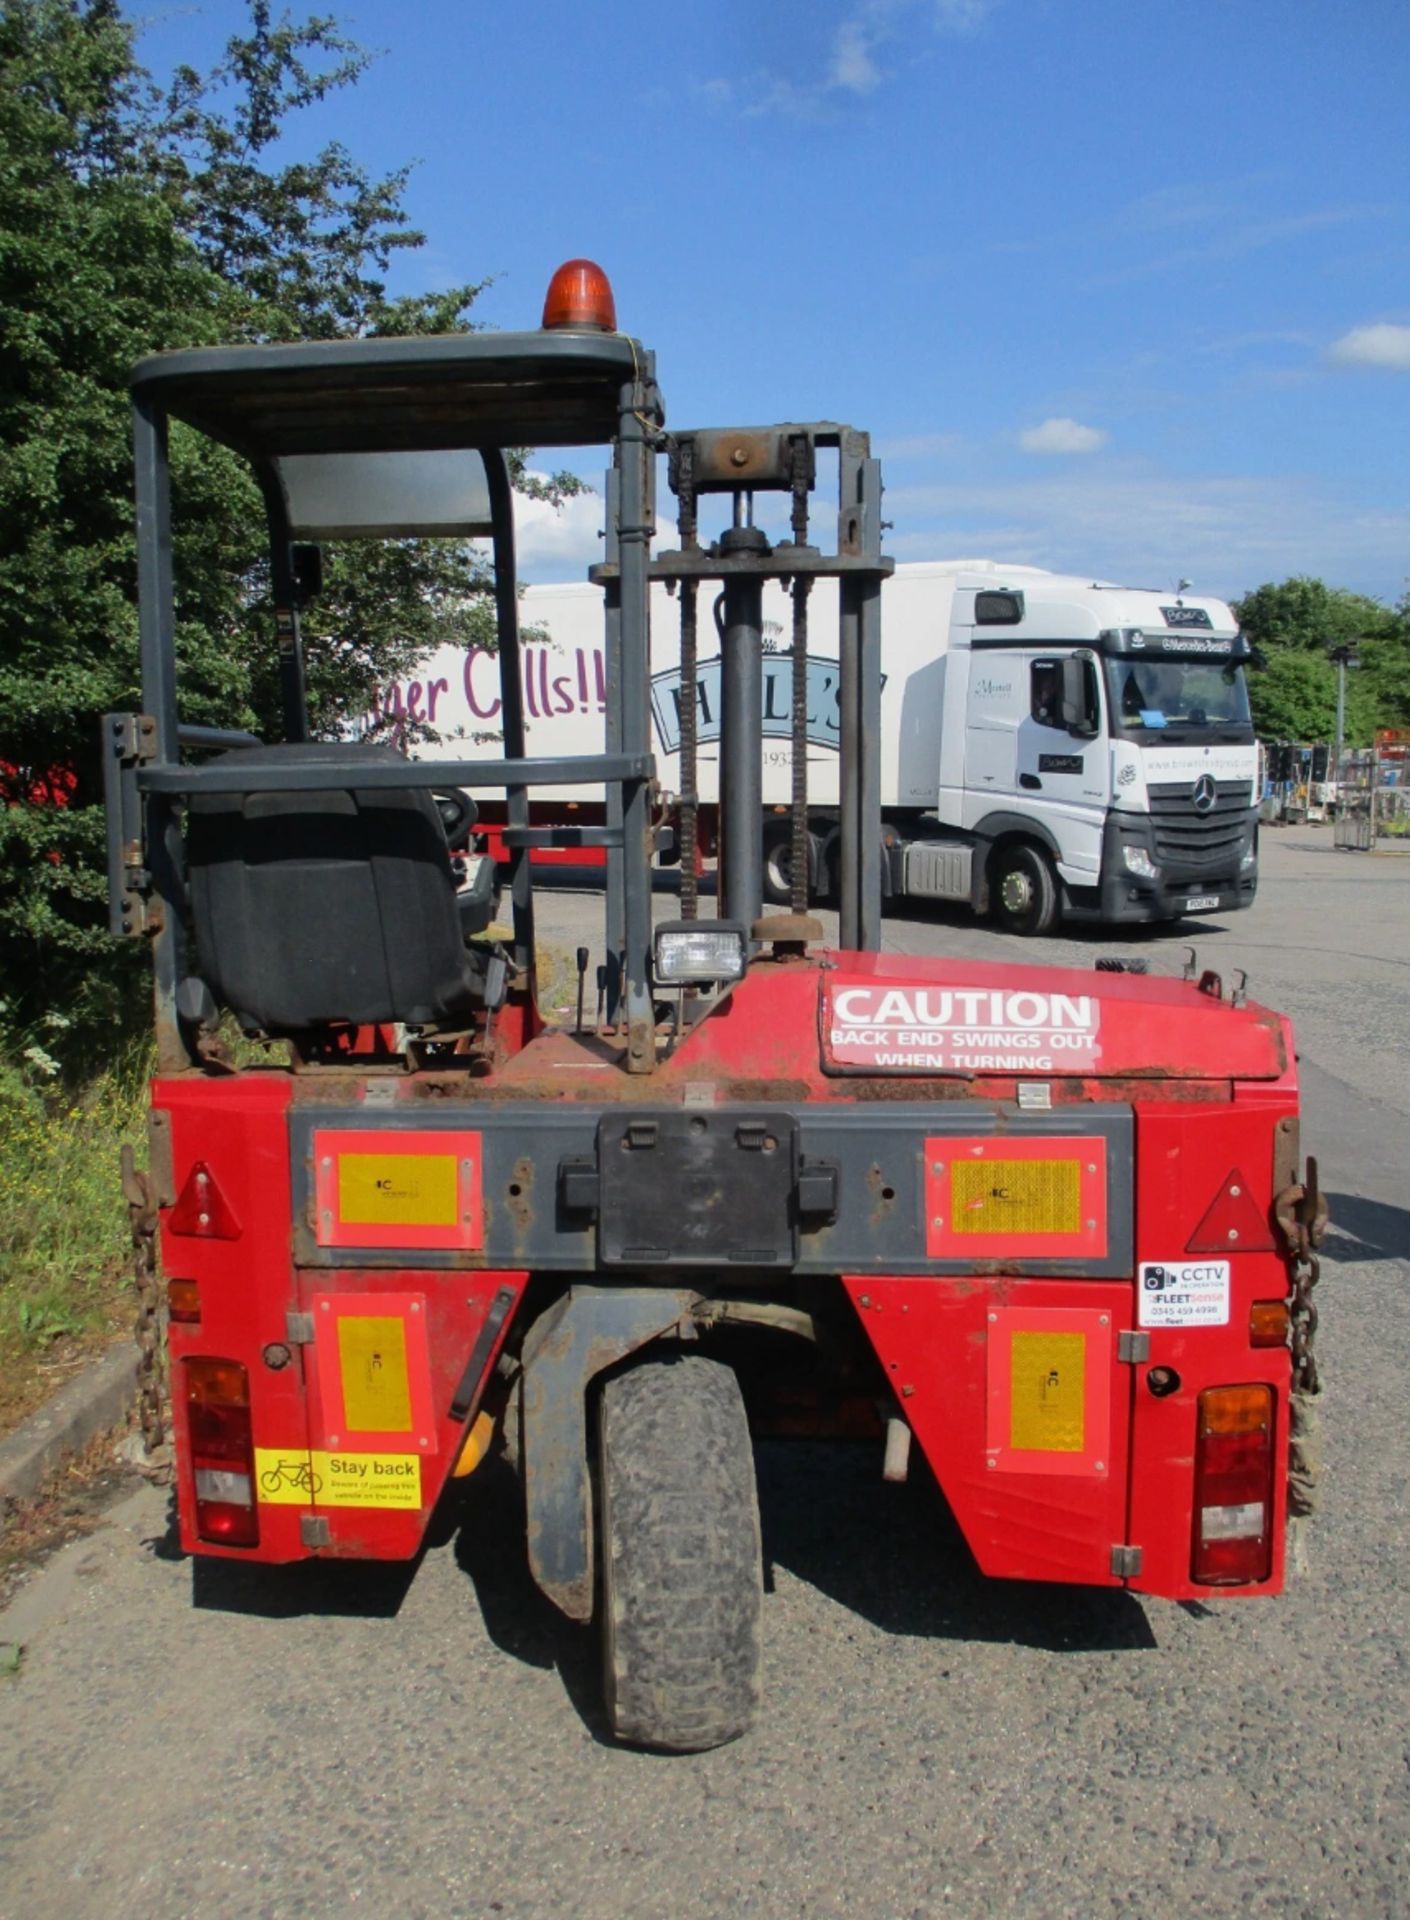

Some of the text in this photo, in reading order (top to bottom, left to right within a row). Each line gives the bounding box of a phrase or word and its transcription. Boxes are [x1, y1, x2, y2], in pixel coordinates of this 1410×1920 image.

[464, 648, 606, 718] Clls!!
[834, 990, 1091, 1027] CAUTION
[831, 1031, 1095, 1050] BACK END SWINGS OUT
[875, 1053, 1053, 1070] WHEN TURNING
[1181, 1266, 1225, 1281] CCTV
[330, 1459, 415, 1477] Stay back
